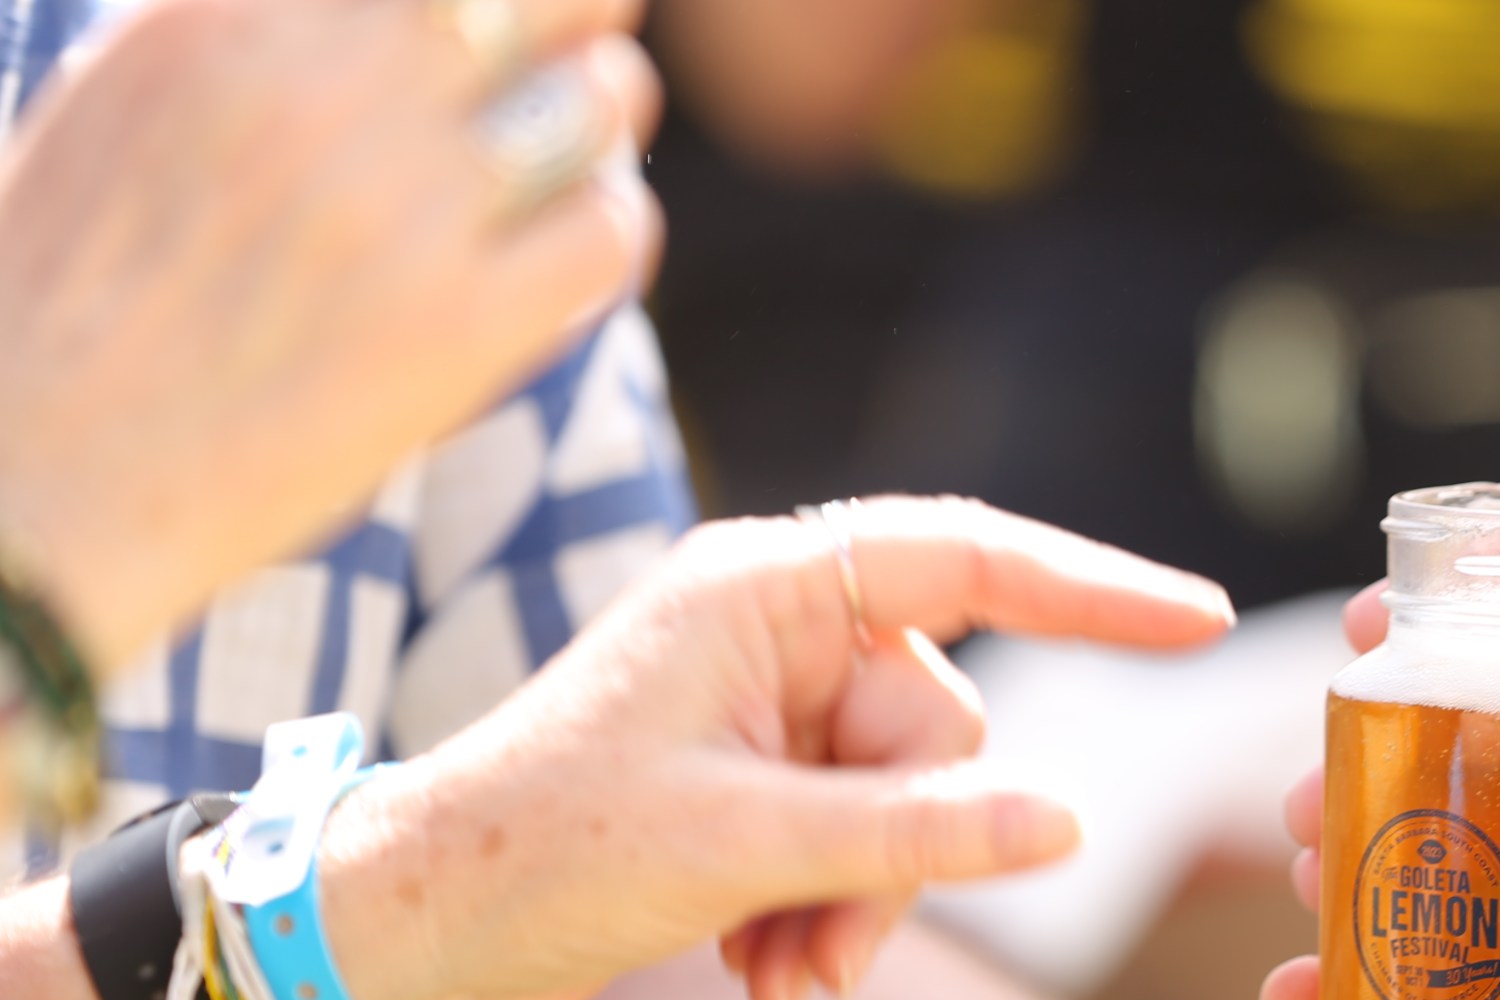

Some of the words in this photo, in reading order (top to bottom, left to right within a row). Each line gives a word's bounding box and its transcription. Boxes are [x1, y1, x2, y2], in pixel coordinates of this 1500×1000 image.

[1396, 827, 1438, 845] BARBARA
[1441, 830, 1473, 853] SOUTH
[1474, 852, 1499, 888] COAST
[1401, 865, 1471, 894] GOLETA
[1372, 886, 1498, 949] LEMON
[1390, 936, 1470, 964] FESTIVAL
[1446, 968, 1460, 986] 30
[1462, 961, 1499, 983] Years!
